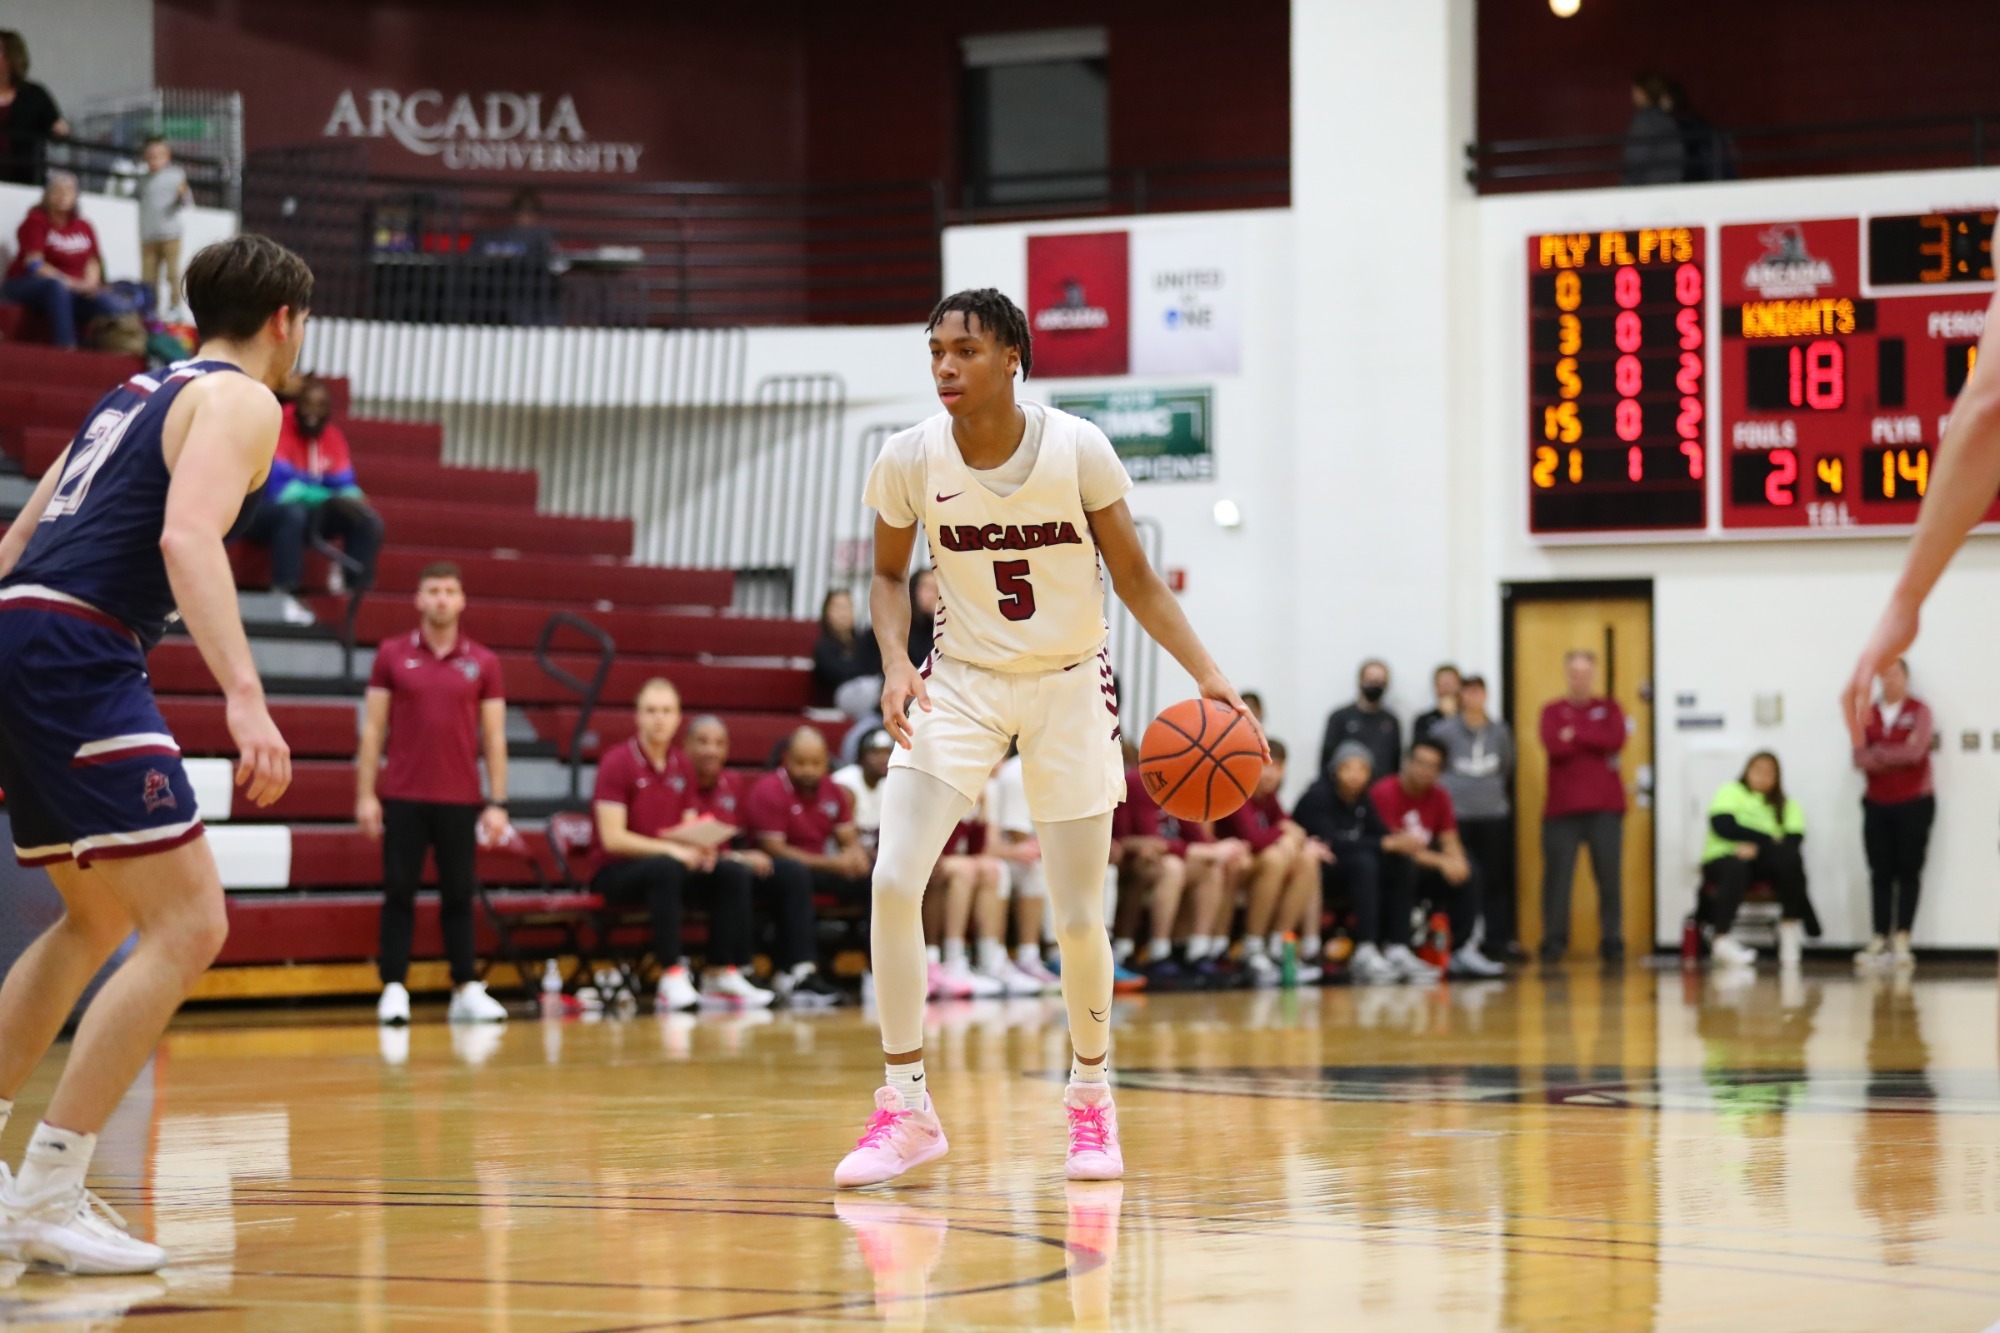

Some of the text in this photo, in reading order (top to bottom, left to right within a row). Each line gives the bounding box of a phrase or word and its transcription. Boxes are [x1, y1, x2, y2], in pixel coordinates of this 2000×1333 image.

[323, 88, 587, 156] ARCADIA
[442, 140, 643, 174] UNIVERSITY
[1639, 227, 1693, 264] PTS
[1555, 263, 1702, 311] 0 0 0
[1559, 307, 1703, 355] 3 0 5
[1741, 298, 1856, 338] KNIGHTS
[1927, 309, 1986, 338] PERIO
[1556, 352, 1703, 399] 5 0 2
[1789, 340, 1844, 410] 18
[1545, 396, 1703, 443] 15 0 2
[1732, 419, 1798, 449] FOULS
[1871, 414, 1923, 444] PLYR
[1533, 440, 1703, 488] 21 1 7
[1765, 449, 1797, 506] 2
[1817, 457, 1843, 494] 4
[1882, 448, 1929, 499] 14
[939, 521, 1082, 552] ARCADIA
[993, 559, 1036, 621] 5
